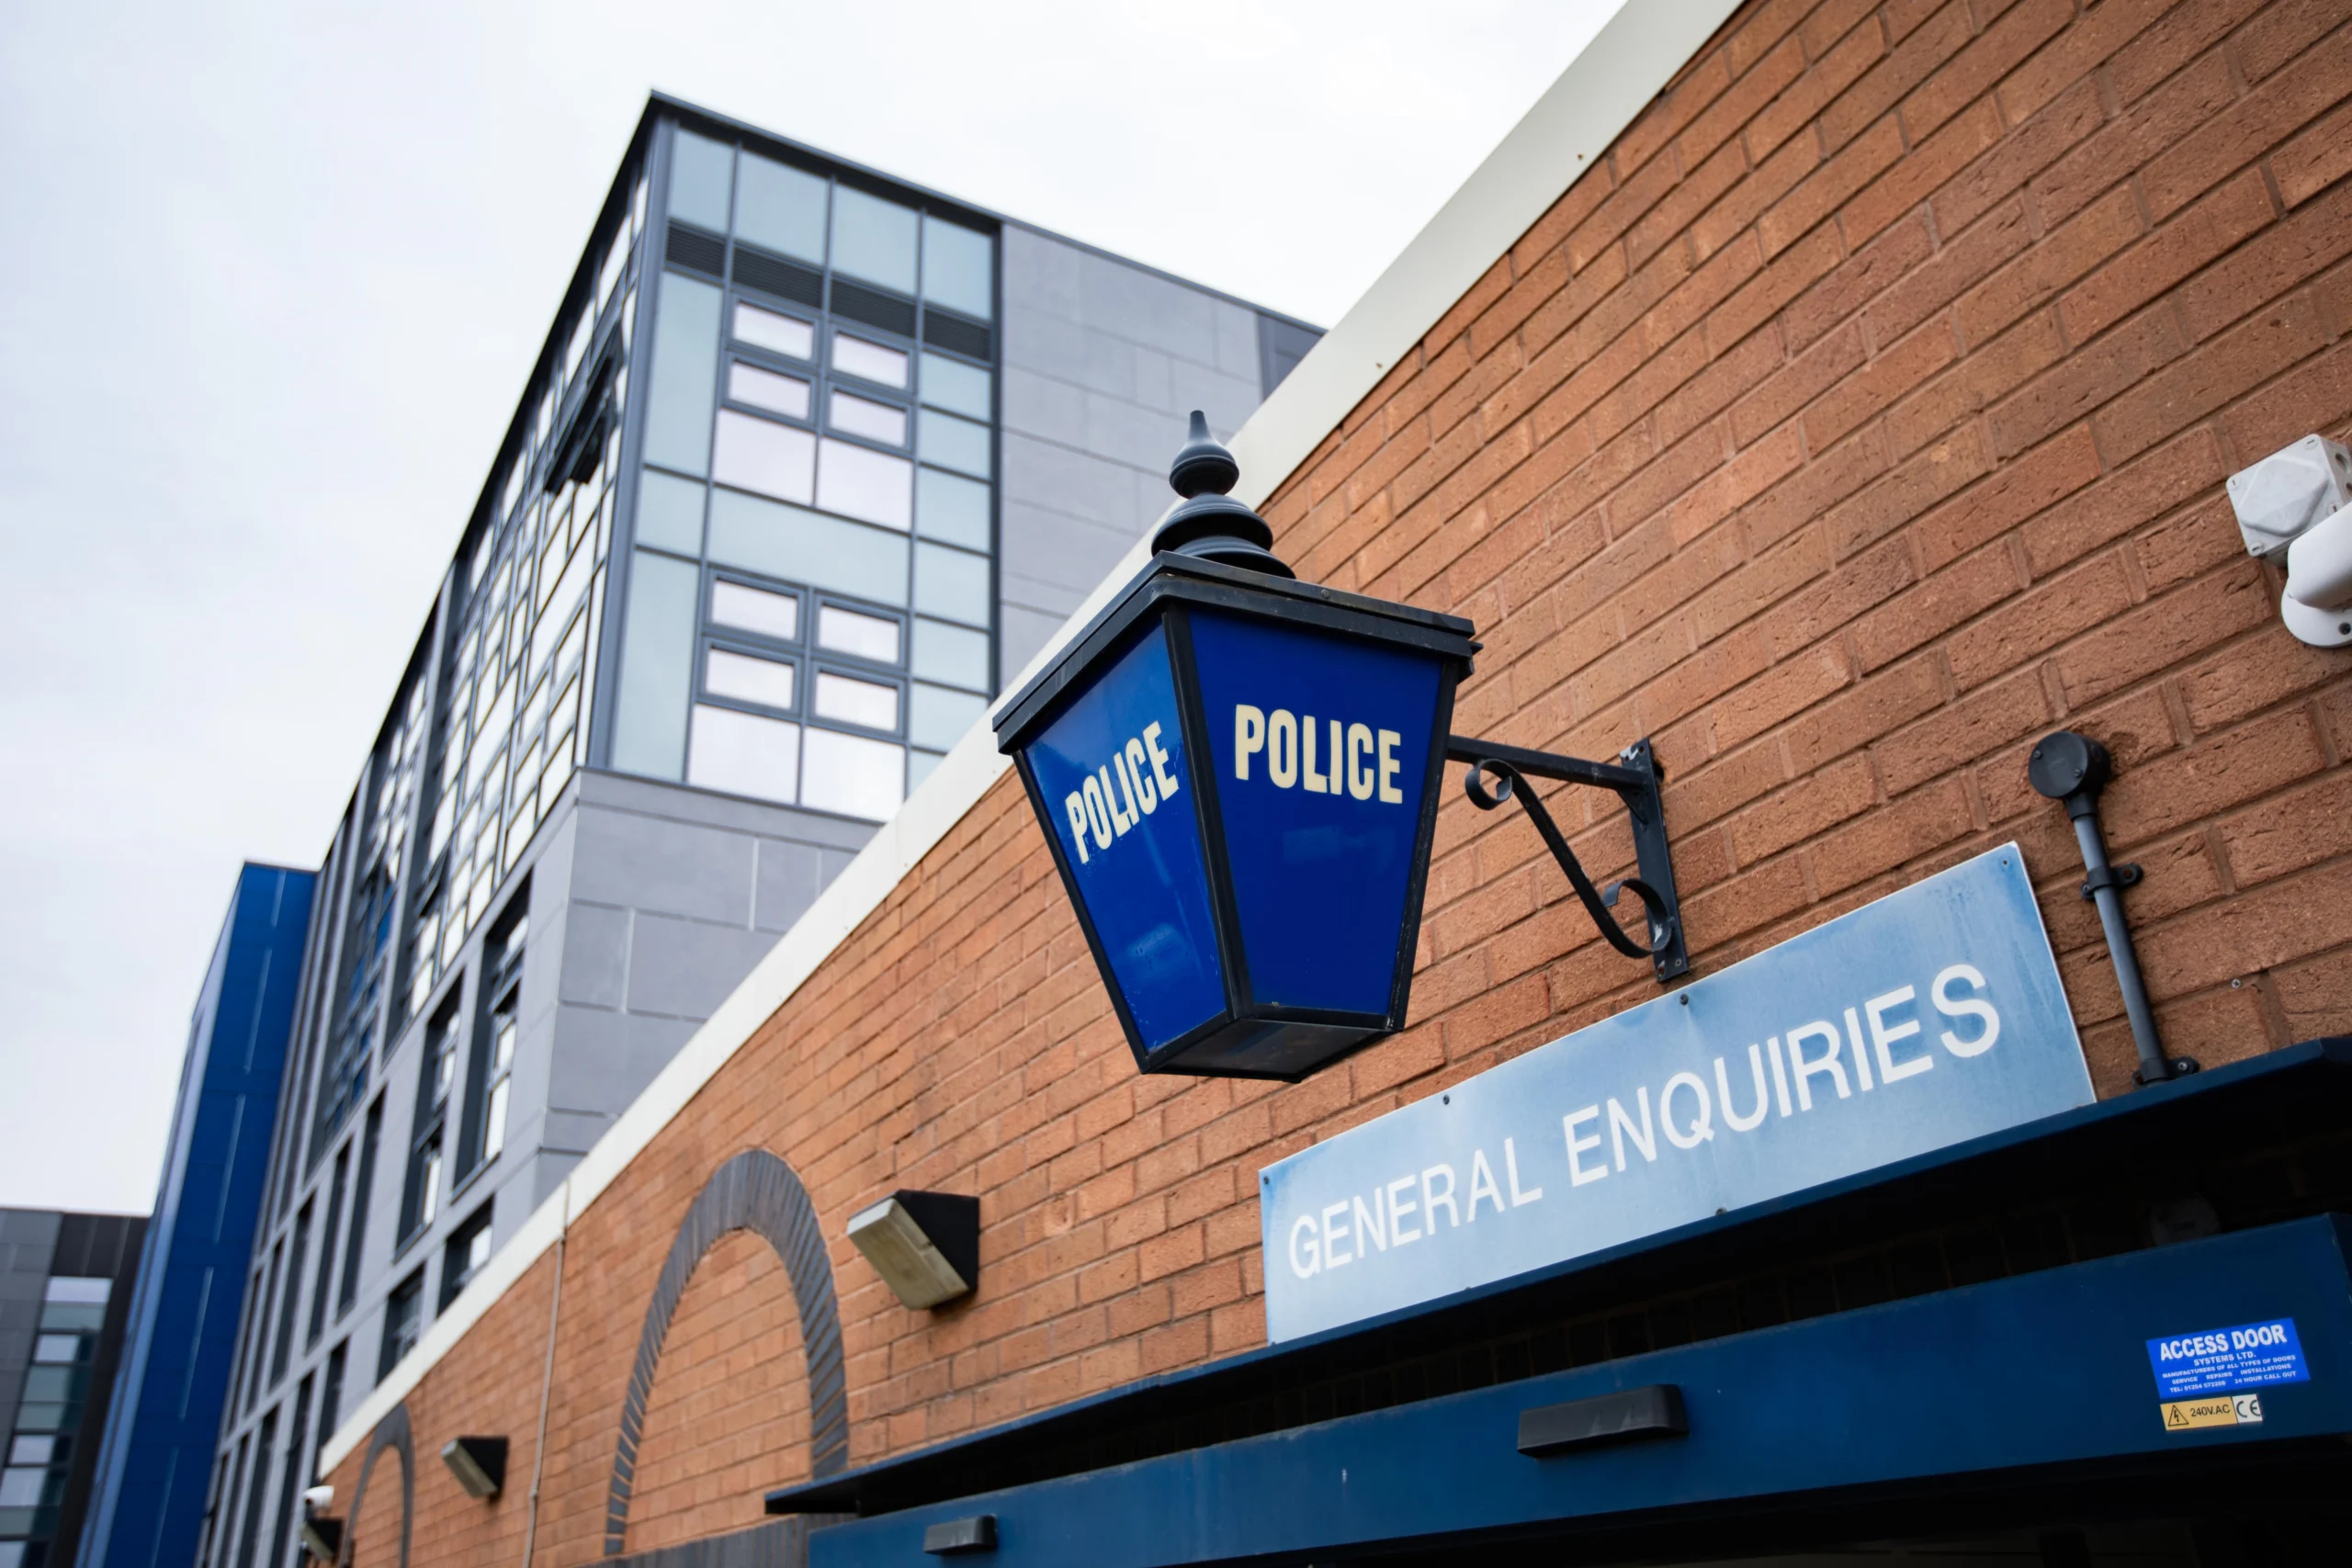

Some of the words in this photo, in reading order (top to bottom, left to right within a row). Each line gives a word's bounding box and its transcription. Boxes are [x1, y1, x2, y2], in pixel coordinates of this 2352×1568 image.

[1235, 704, 1403, 805] POLICE
[1065, 720, 1179, 864] POLICE
[1289, 1137, 1543, 1280] GENERAL
[1562, 964, 2001, 1188] ENQUIRIES
[2160, 1333, 2229, 1361] ACCESS
[2231, 1324, 2288, 1349] DOOR
[2193, 1354, 2234, 1366] SYSTEMS
[2236, 1351, 2256, 1359] LTD.
[2162, 1366, 2216, 1379] MANUFACTURERS
[2172, 1376, 2199, 1384] SERVICE
[2206, 1371, 2233, 1380] REPAIRS
[2240, 1363, 2291, 1375] INSTALLATIONS
